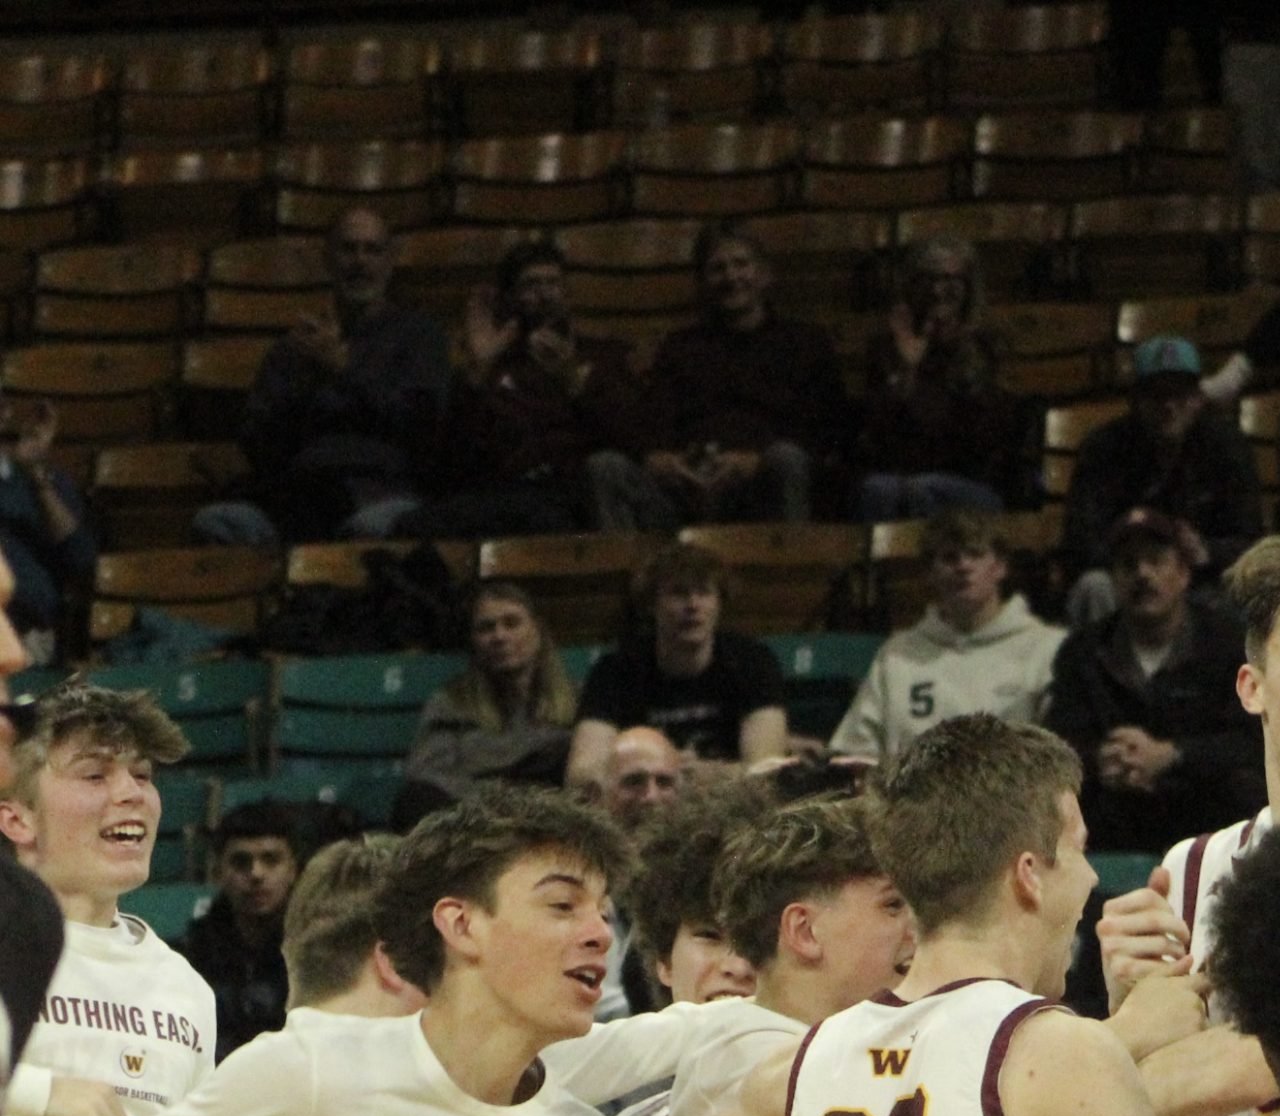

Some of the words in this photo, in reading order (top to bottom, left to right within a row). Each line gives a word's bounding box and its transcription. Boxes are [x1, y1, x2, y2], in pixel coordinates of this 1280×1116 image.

[909, 682, 935, 718] 5
[124, 1054, 145, 1073] W
[866, 1047, 912, 1079] W
